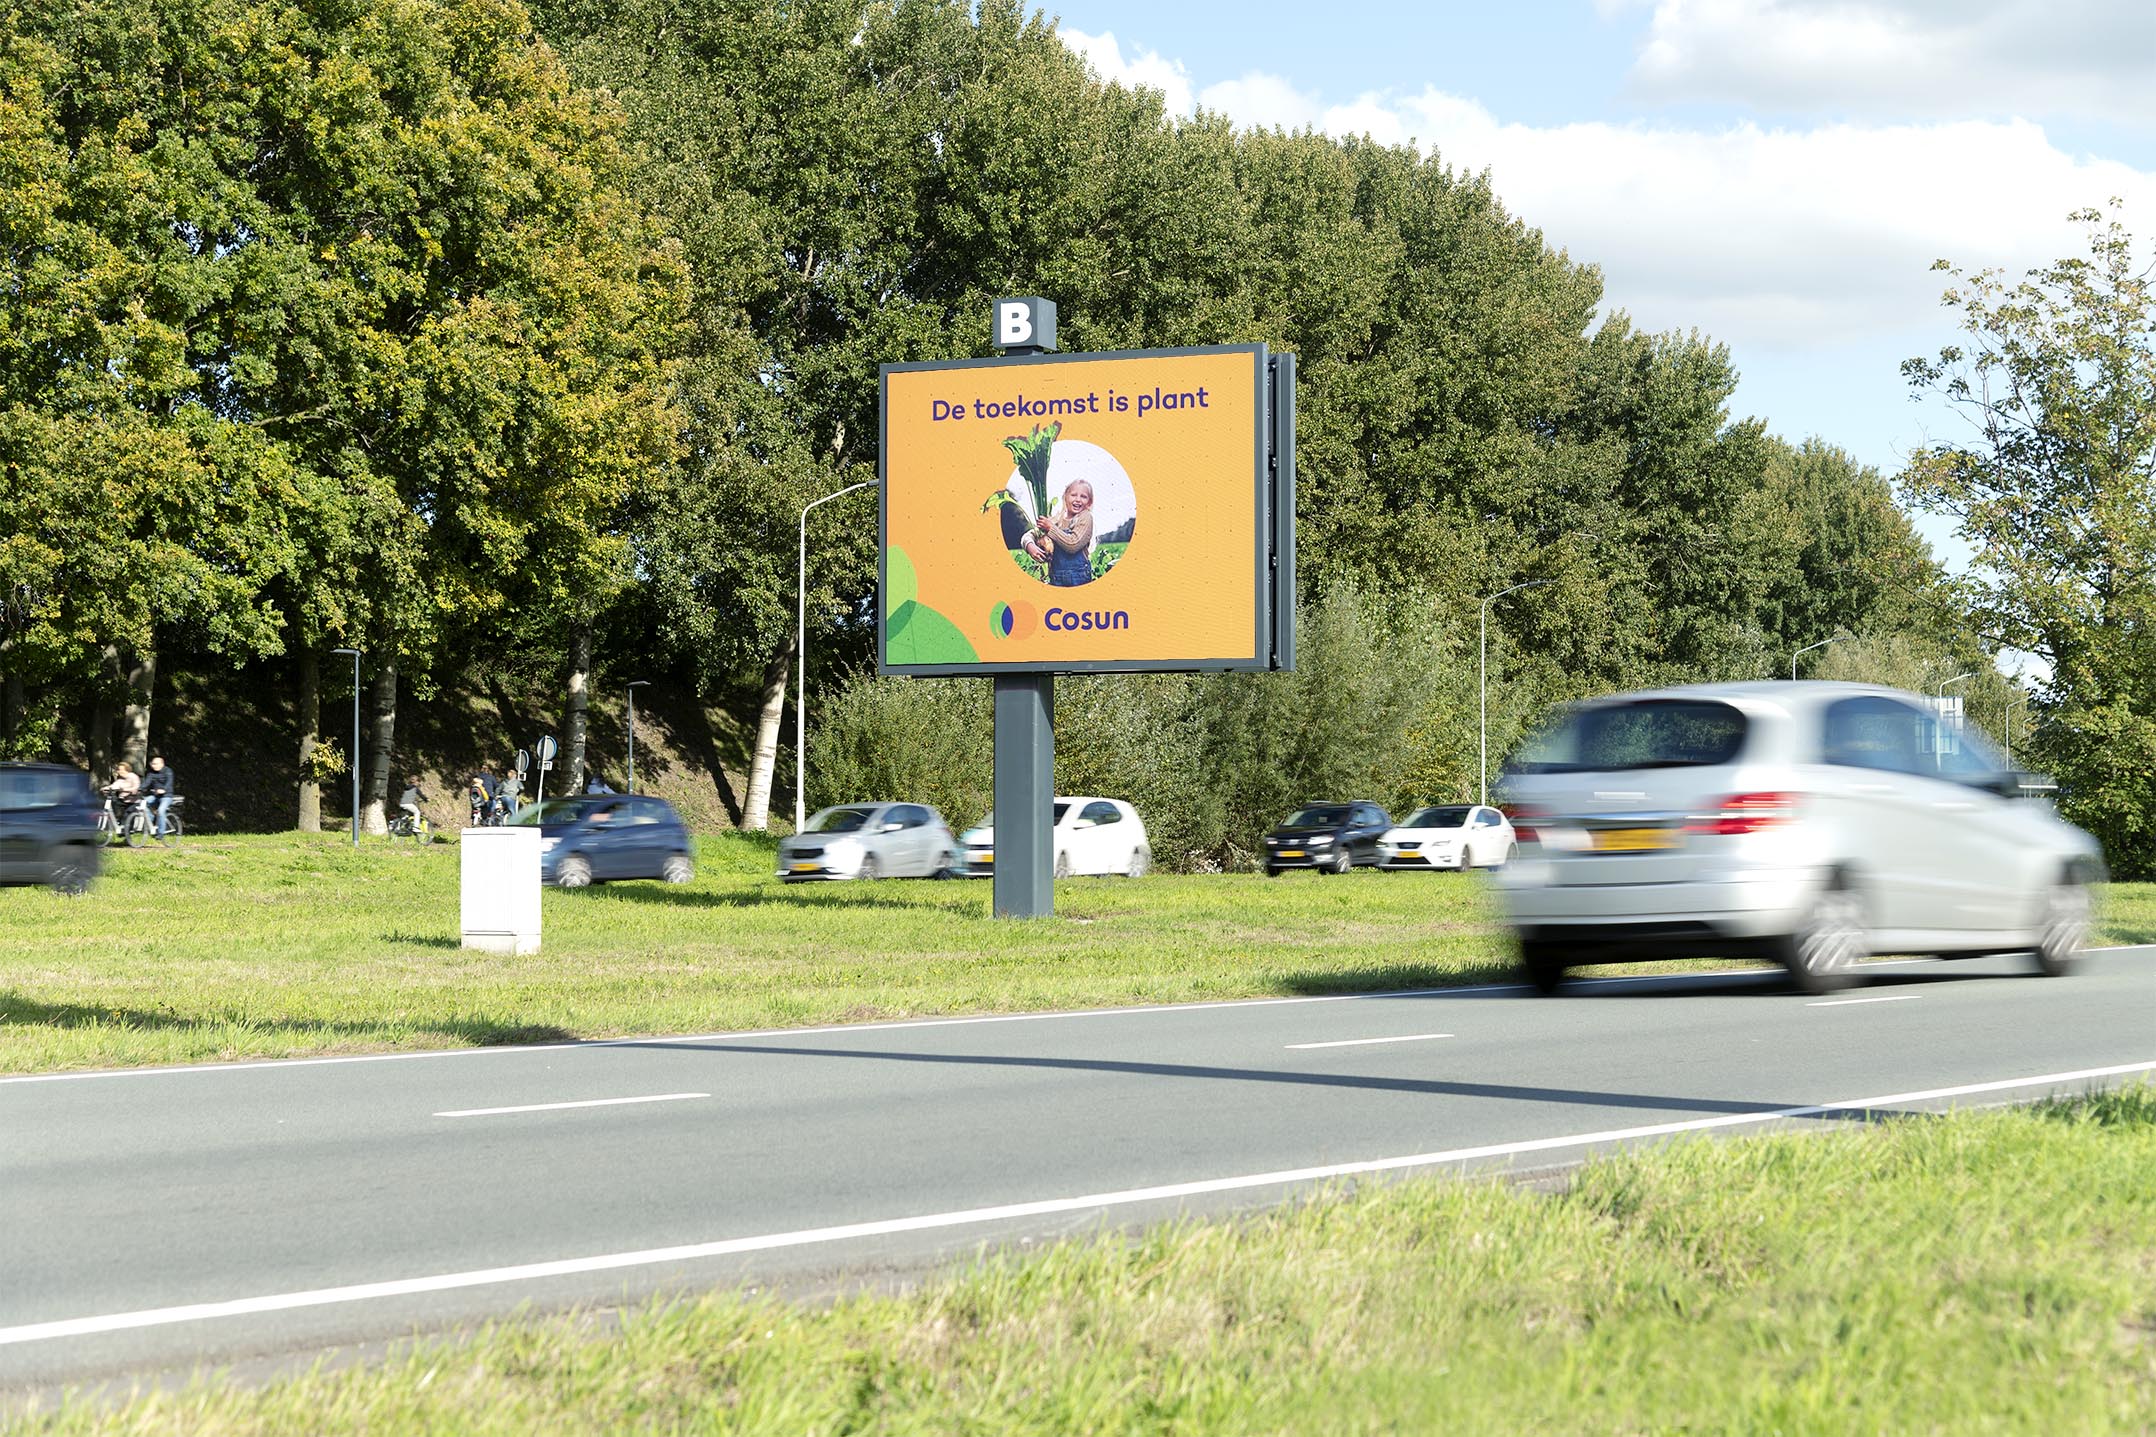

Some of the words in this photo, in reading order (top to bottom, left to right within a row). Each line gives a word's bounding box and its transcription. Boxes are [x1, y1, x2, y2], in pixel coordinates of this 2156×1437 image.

[1000, 302, 1033, 344] B
[932, 399, 966, 422] De
[973, 392, 1099, 419] toekomst
[1108, 389, 1129, 412] is
[1137, 386, 1209, 418] plant
[1044, 607, 1129, 632] Cosun
